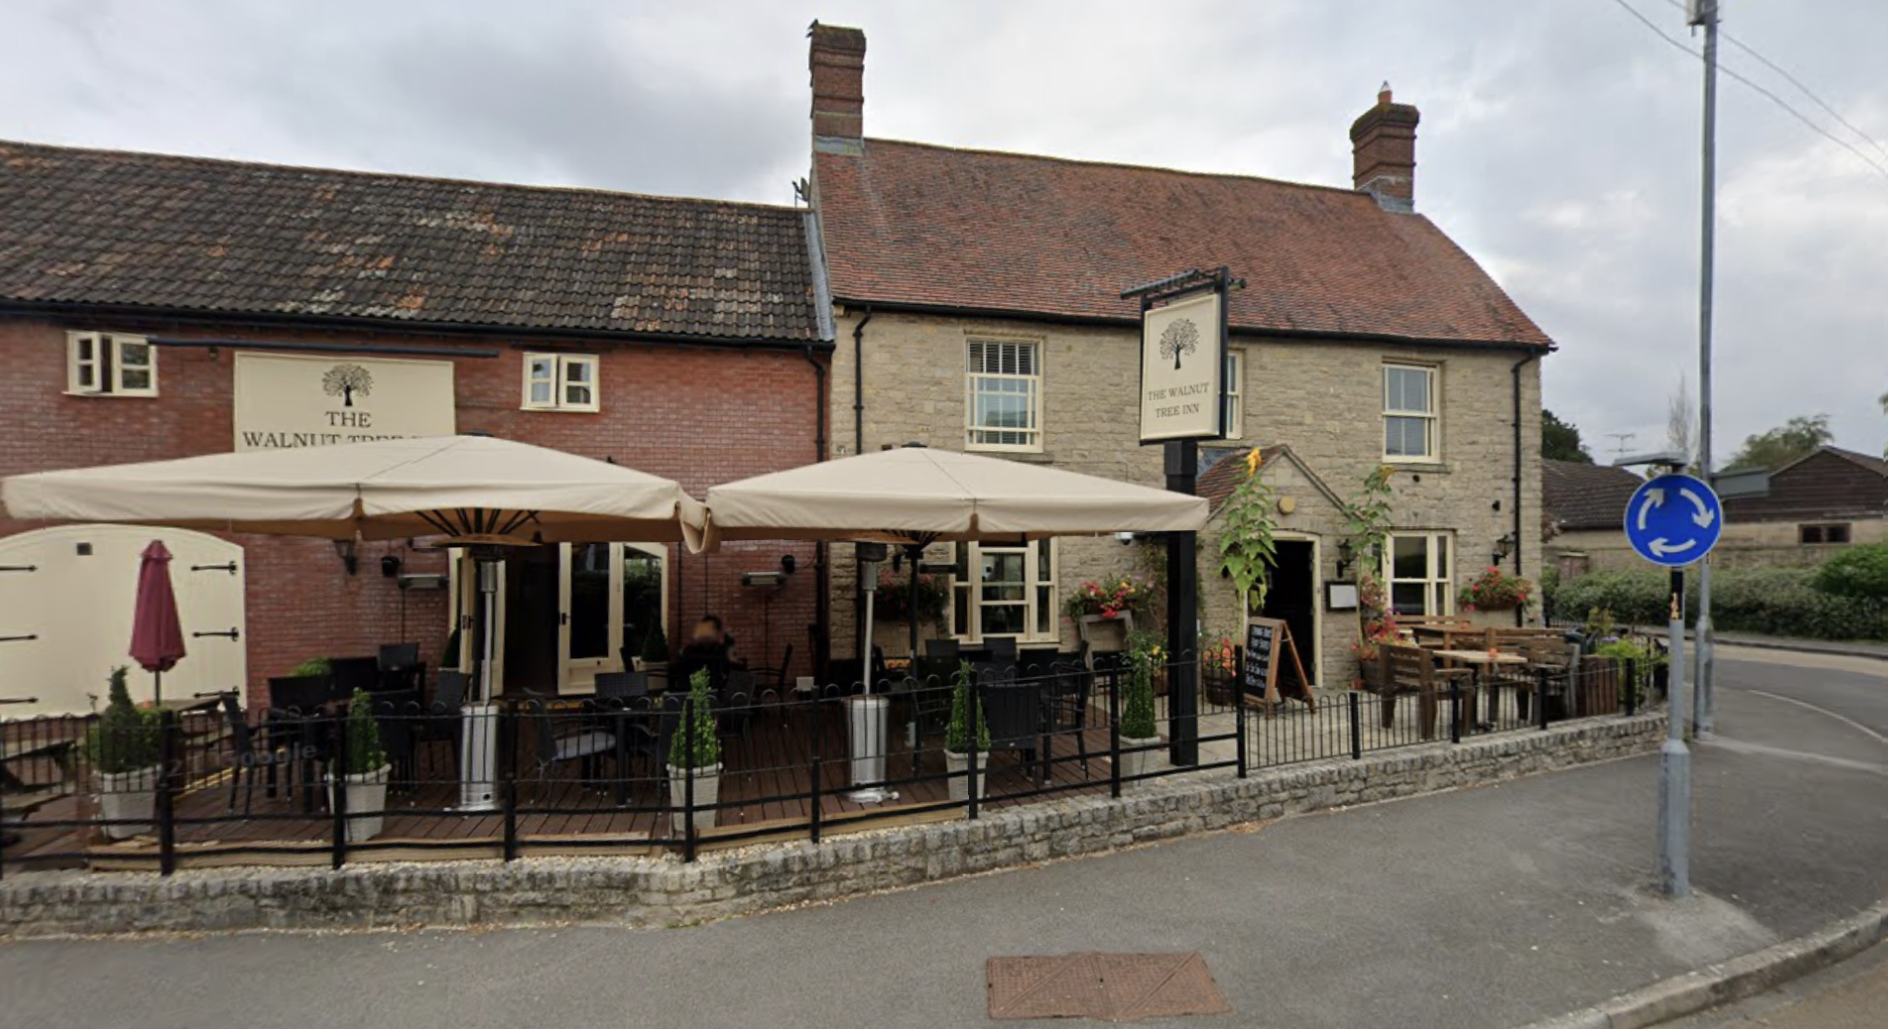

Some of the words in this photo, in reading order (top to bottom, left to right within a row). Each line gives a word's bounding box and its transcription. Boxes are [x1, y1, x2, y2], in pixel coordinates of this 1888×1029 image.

[1148, 389, 1167, 401] THE
[1168, 382, 1209, 397] WALNUT
[1155, 405, 1180, 418] TREE
[1182, 403, 1199, 415] INN
[325, 411, 371, 428] THE
[242, 431, 341, 448] WALNUT
